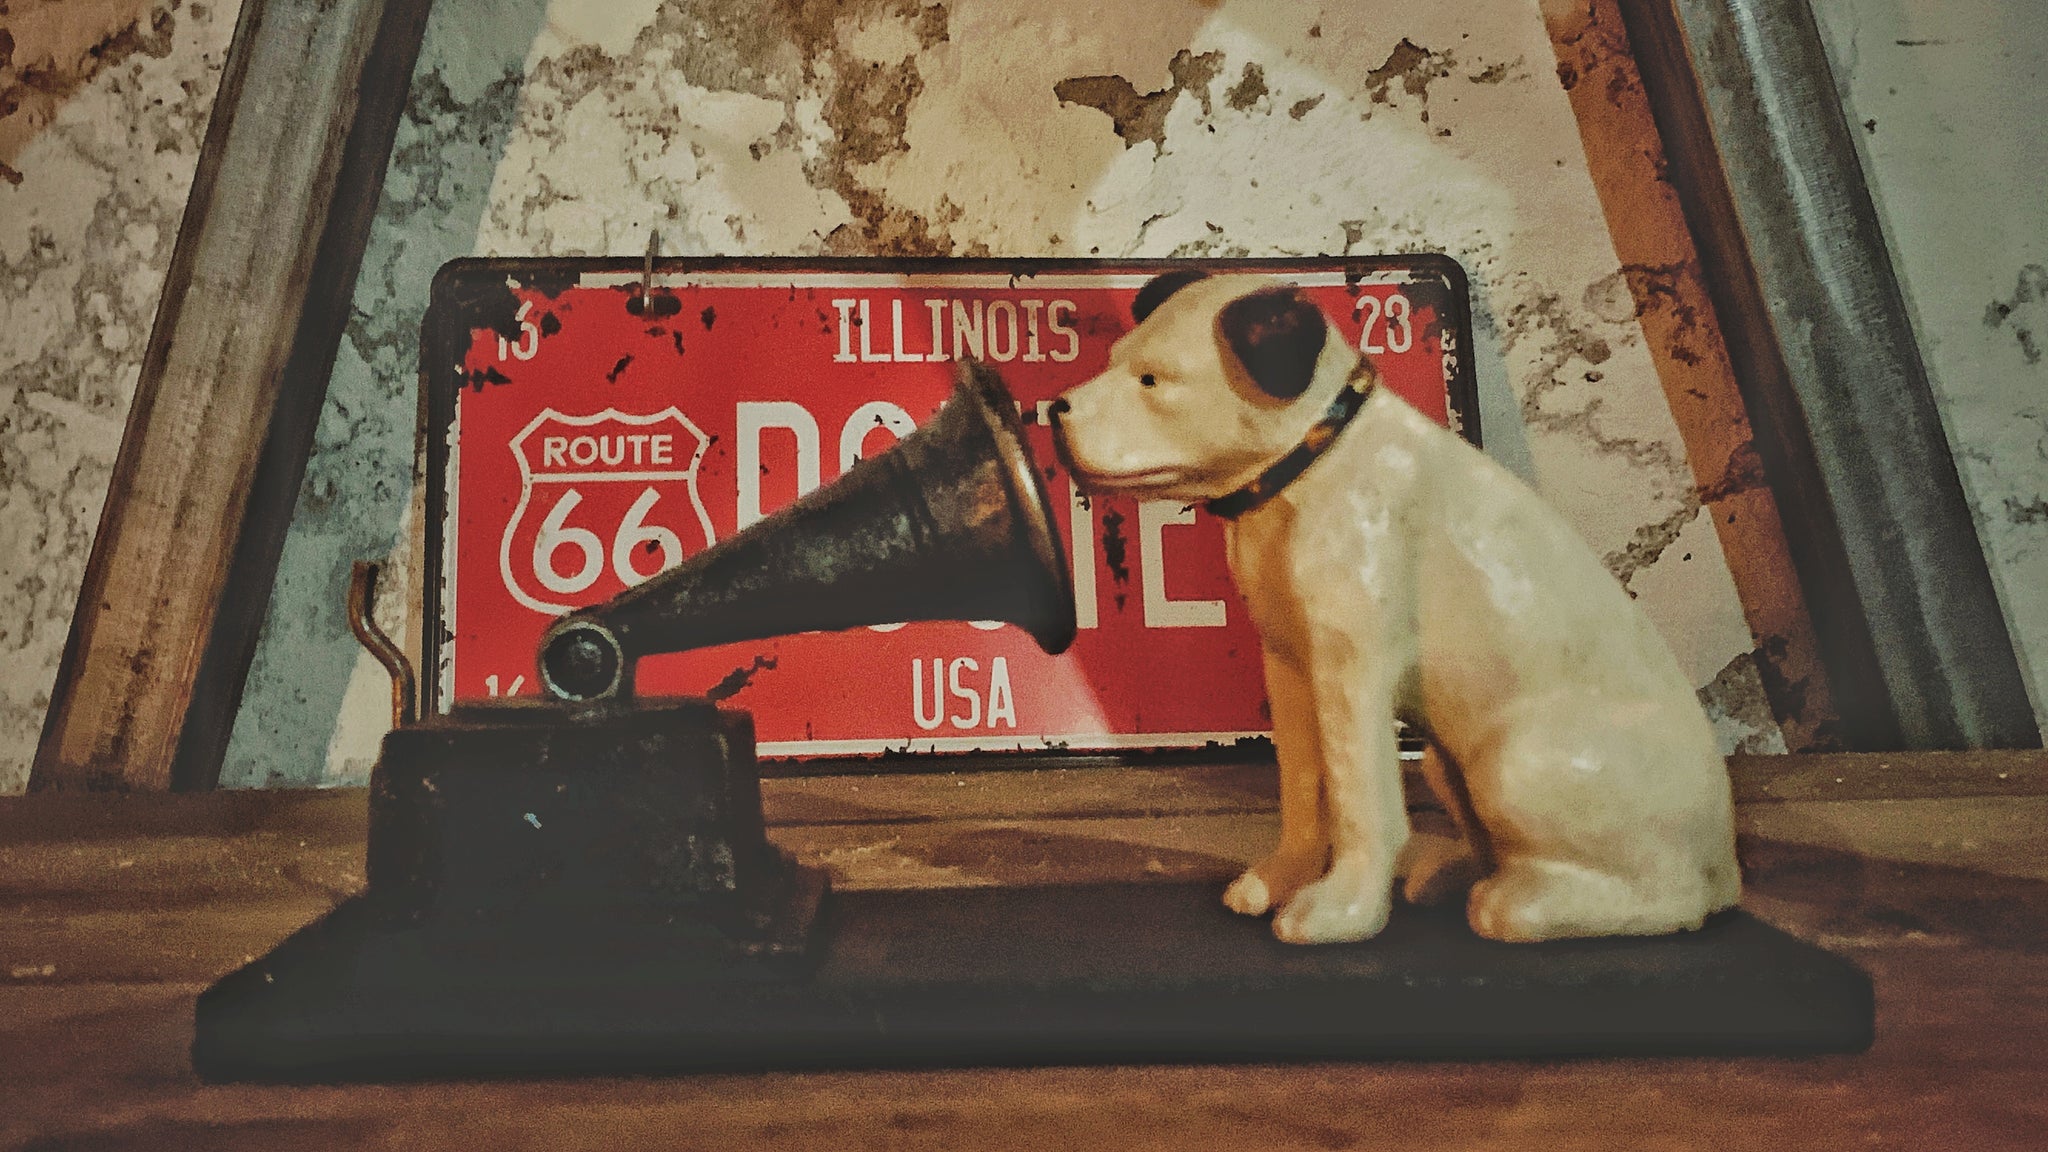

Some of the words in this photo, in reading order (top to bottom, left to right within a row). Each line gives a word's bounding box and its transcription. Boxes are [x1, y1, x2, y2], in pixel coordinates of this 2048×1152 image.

[832, 299, 1079, 362] ILLINOIS
[543, 435, 673, 467] ROUTE
[533, 487, 683, 594] 66
[736, 400, 1227, 631] RTE
[912, 657, 1016, 730] USA
